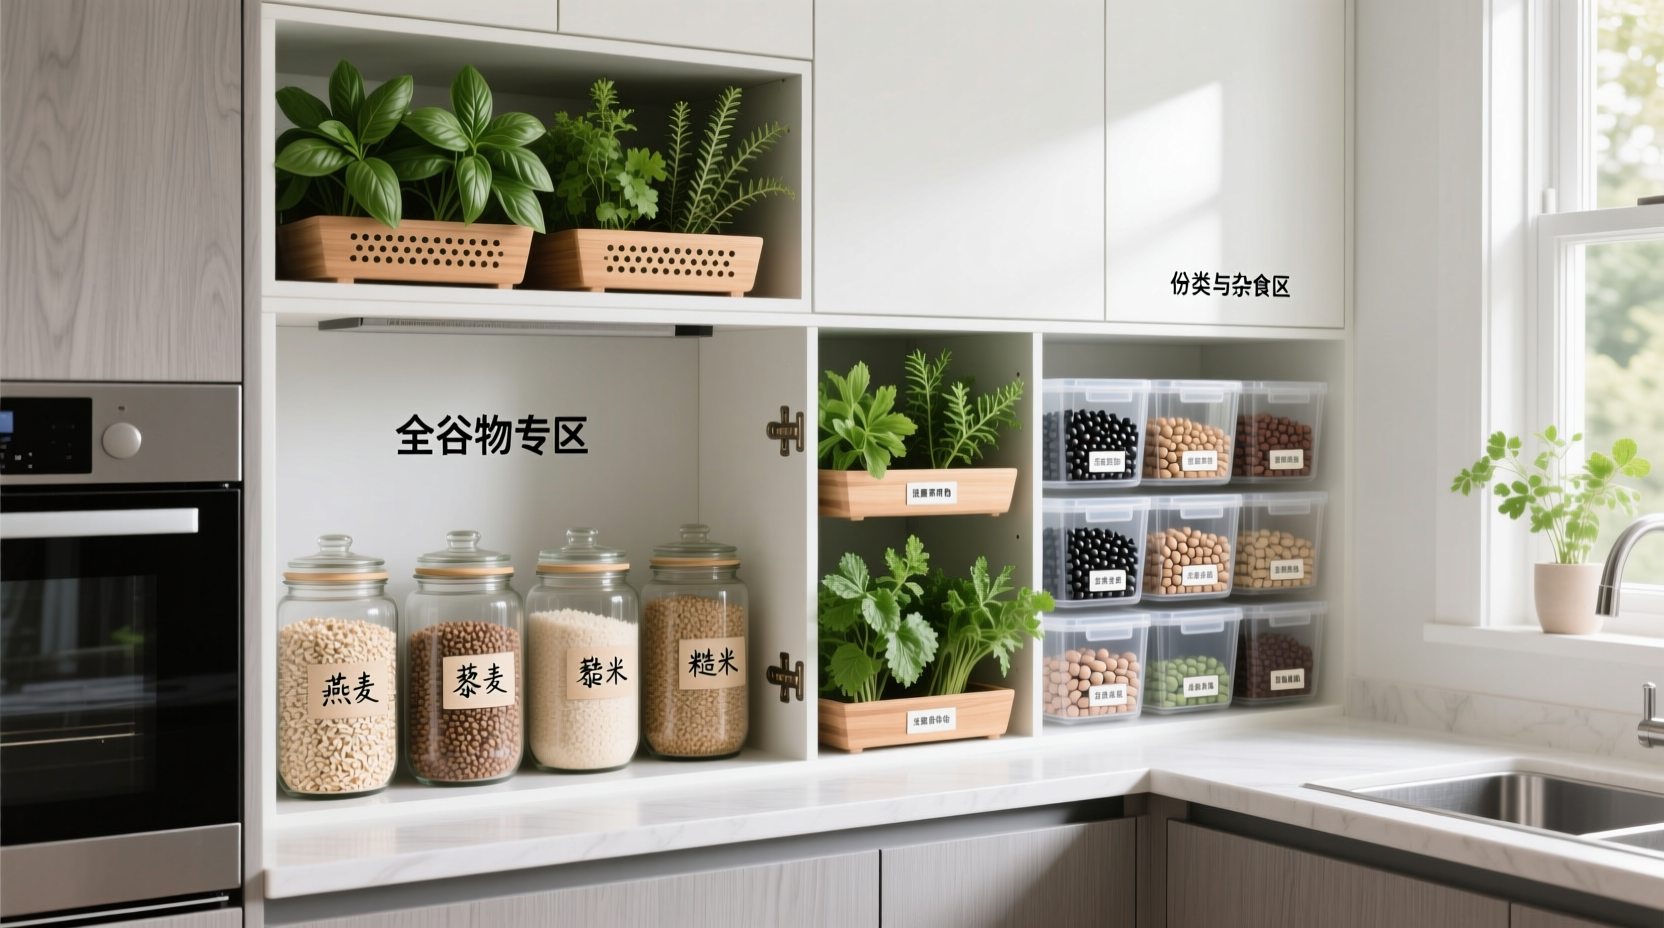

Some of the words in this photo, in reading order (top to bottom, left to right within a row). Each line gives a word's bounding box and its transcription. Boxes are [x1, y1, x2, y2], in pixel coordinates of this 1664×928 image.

[1170, 271, 1291, 298] 份类与杂食区
[395, 413, 589, 456] 全谷物专区
[688, 647, 739, 678] 糙米
[322, 671, 379, 707] 燕麦
